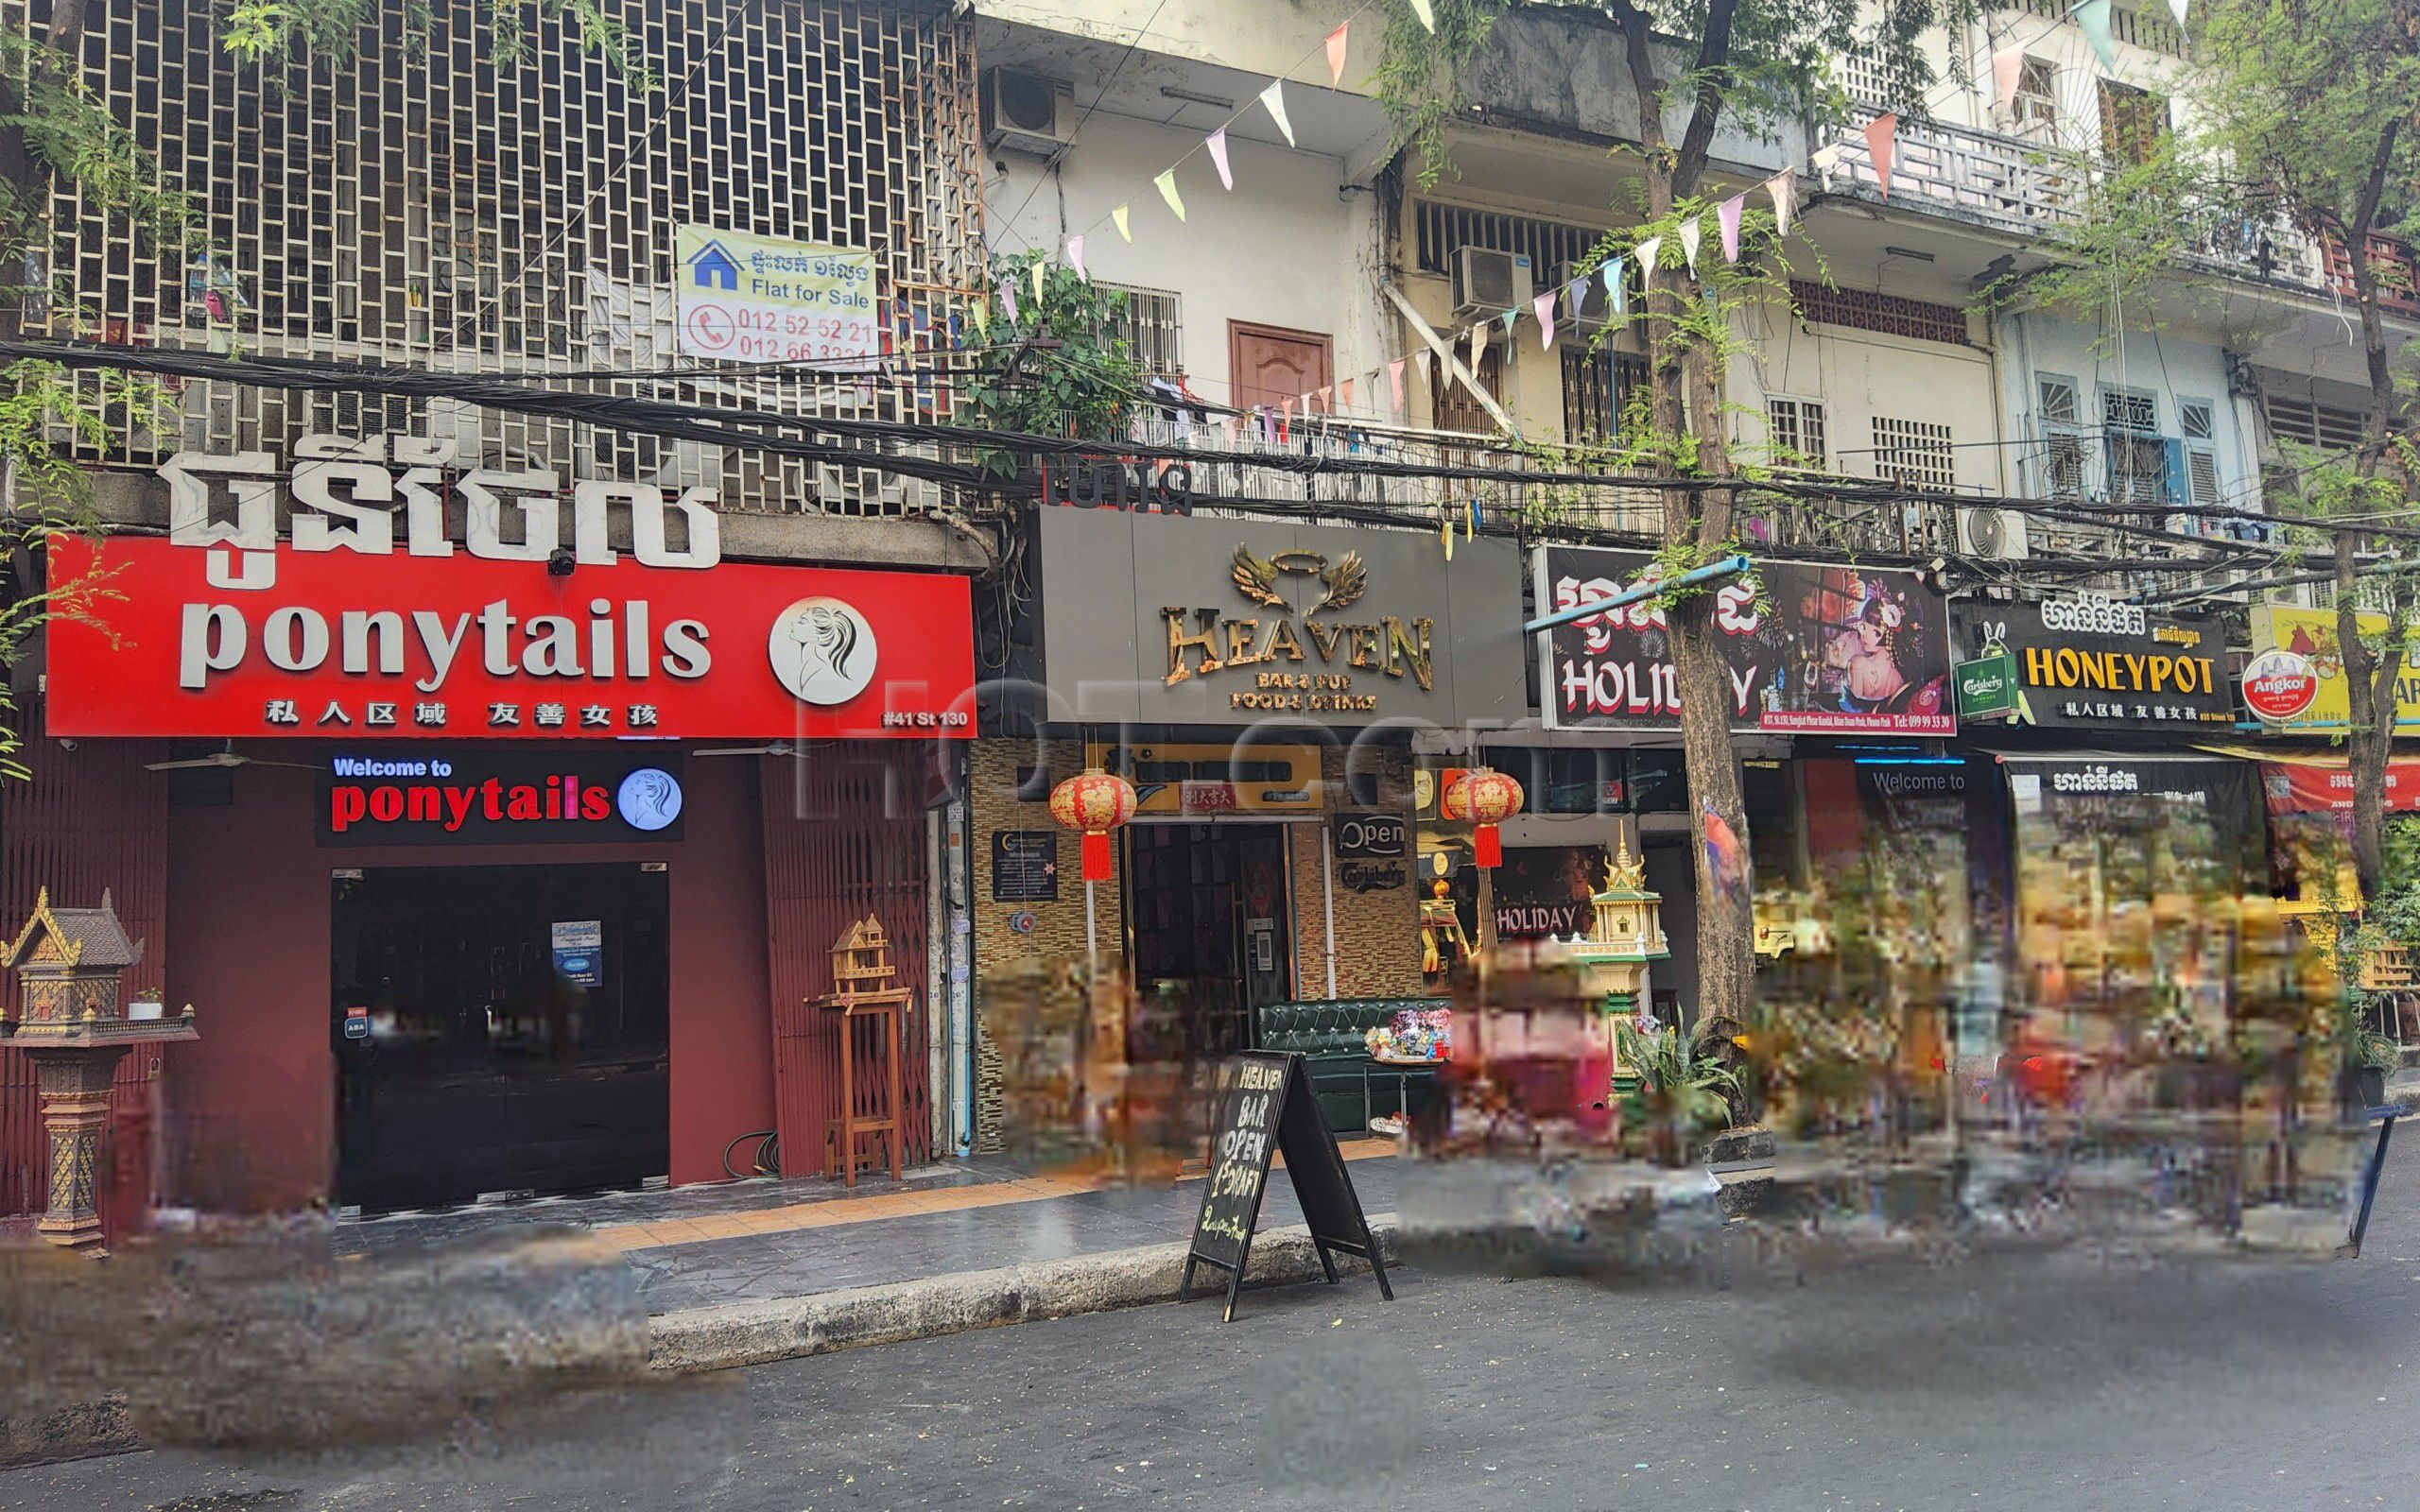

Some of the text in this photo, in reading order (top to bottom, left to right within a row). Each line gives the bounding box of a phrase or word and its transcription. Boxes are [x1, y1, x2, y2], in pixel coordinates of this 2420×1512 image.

[752, 279, 870, 309] Flat for Sale
[738, 308, 872, 344] 012 52 52 21
[740, 335, 779, 359] 012
[786, 341, 812, 361] 66
[180, 597, 713, 694] ponytails
[1159, 606, 1434, 692] HEAVEN
[1255, 672, 1295, 689] BAR
[1298, 673, 1311, 690] &
[2024, 647, 2216, 696] HONEYPOT
[1561, 659, 1757, 718] HOLIY
[1963, 677, 2003, 696] Carlsberg
[2254, 678, 2307, 695] Angkor
[266, 699, 659, 728] 私人区域 友善女孩
[1231, 692, 1378, 711] FOOD & DRINKS
[2065, 701, 2198, 721] 私人区域 友善女孩
[883, 712, 968, 726] #41 St 130
[1893, 714, 1909, 728] Tel:
[1909, 715, 1921, 728] 099
[1922, 715, 1930, 728] 99
[1941, 715, 1950, 729] 30
[334, 759, 452, 777] Welcome to
[1873, 772, 1965, 790] Welcome to
[331, 775, 612, 833] ponytails
[1340, 821, 1405, 850] Open
[1496, 906, 1577, 934] HOLIDAY
[348, 1023, 365, 1032] ABA
[1236, 1093, 1270, 1129] BAR
[1224, 1127, 1267, 1162] OPEN
